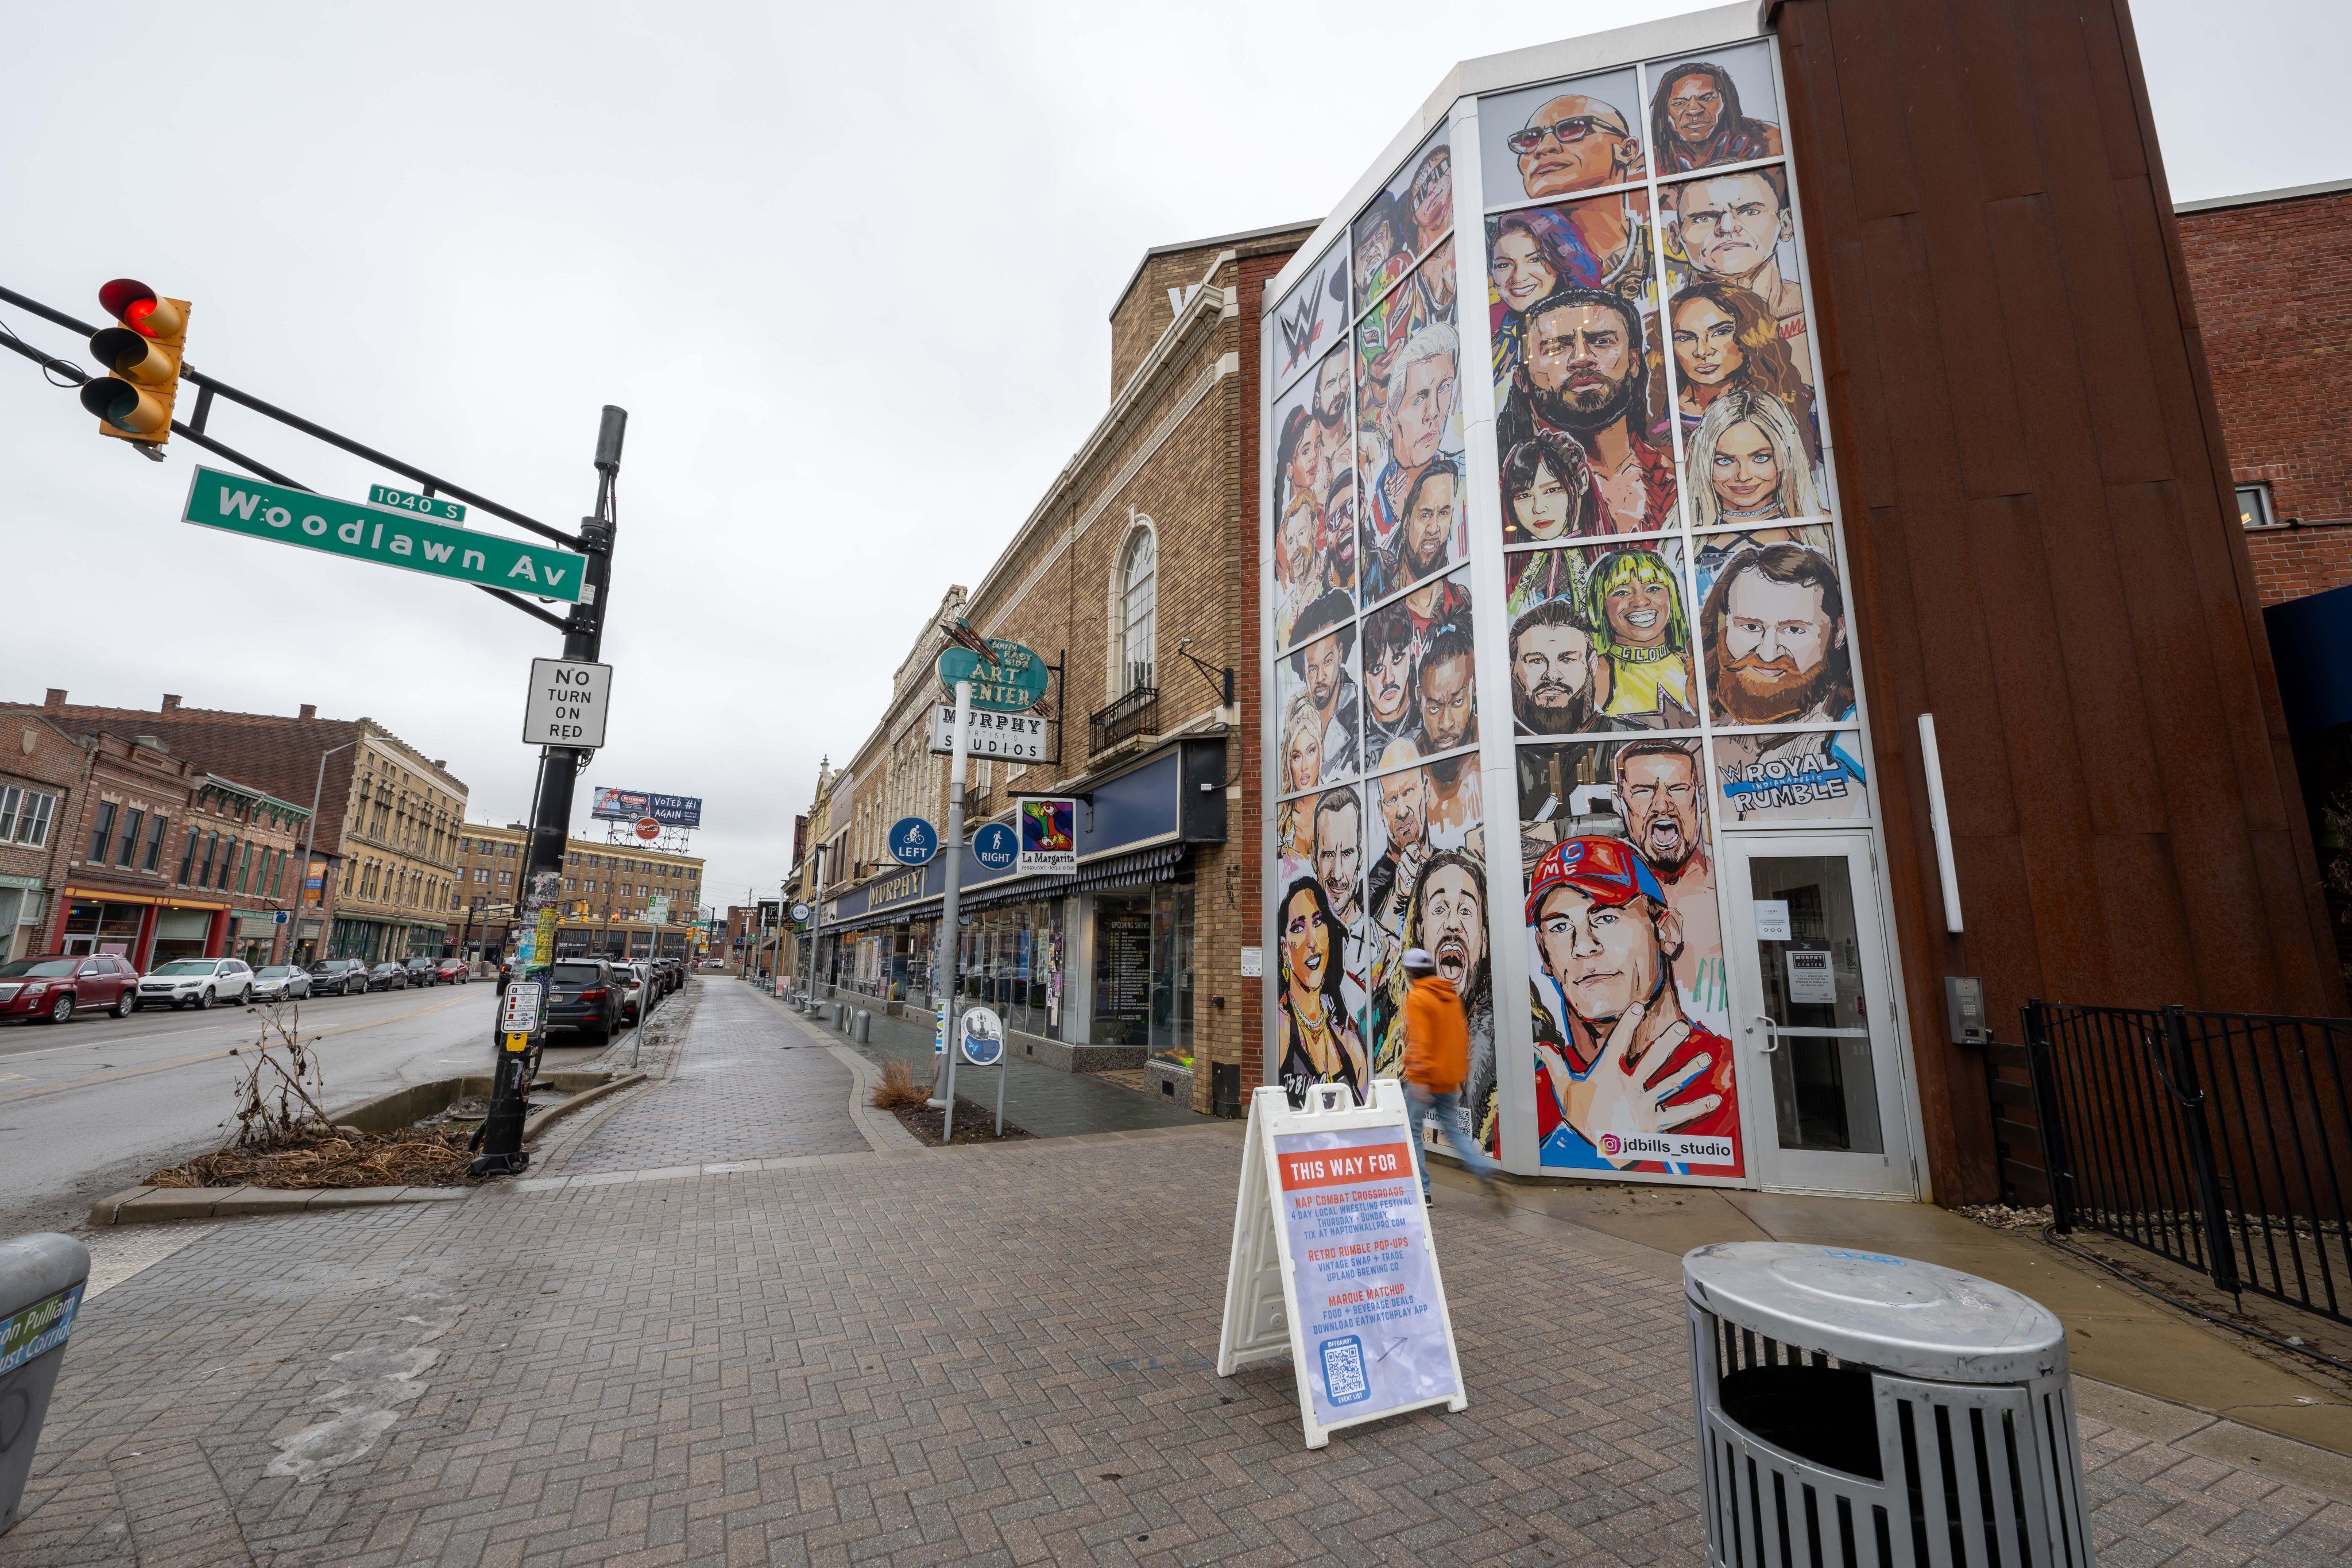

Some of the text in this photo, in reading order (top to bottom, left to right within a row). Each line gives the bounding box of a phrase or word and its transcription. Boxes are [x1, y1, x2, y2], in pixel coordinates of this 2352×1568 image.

[377, 489, 458, 520] 1040 S
[219, 486, 566, 586] Woodlawn Av
[992, 641, 1018, 652] SOUTH
[1004, 651, 1032, 661] EAST
[1005, 658, 1028, 668] SIDE
[555, 668, 590, 686] NO
[970, 663, 1022, 684] ART
[547, 688, 592, 704] TURN
[970, 682, 1030, 706] ENTER
[555, 706, 580, 720] ON
[942, 708, 1041, 735] MURPHY
[550, 723, 583, 738] RED
[967, 729, 1018, 741] ARTIST'S
[944, 735, 1036, 757] SUDIOS
[1745, 753, 1840, 783] ROYAL
[1752, 775, 1822, 790] INDIANAPOLIS
[655, 797, 681, 807] VOTED
[685, 800, 696, 809] #1
[1733, 777, 1848, 813] RUMBLE
[655, 810, 681, 819] AGAIN
[899, 847, 927, 858] LEFT
[981, 852, 1011, 862] RIGHT
[1022, 853, 1074, 866] La Margarita
[1542, 861, 1578, 880] ME
[870, 869, 923, 907] MURPHY
[650, 898, 655, 906] 2
[1623, 1138, 1731, 1156] jdbills_studio
[1290, 1153, 1397, 1180] THIS WAY FOR
[1295, 1186, 1405, 1209] NAP COMBAT CROSSROADS
[1291, 1197, 1413, 1221] 4 DAY LOCAL WRESTLING FESTIVAL
[1304, 1218, 1406, 1240] TIX AT NAPTOWNALLPRO.COM
[1317, 1215, 1353, 1228] THURSDAY
[1361, 1211, 1387, 1222] SUNDAY
[1308, 1237, 1409, 1262] RETRO RUMBLE POP-UPS
[1318, 1259, 1349, 1272] VINTAGE
[1351, 1255, 1371, 1267] SWAP
[1382, 1250, 1405, 1262] TRADE
[1327, 1262, 1399, 1282] UPLAND BREWING CO
[1328, 1283, 1405, 1307] MARQUE MATCHUP
[1323, 1295, 1414, 1321] FOOD + BEVERAGE DEALS
[0, 1296, 76, 1345] on Pulliam
[1313, 1304, 1428, 1335] DOWNLOAD EATWATCHPLAY APP
[1338, 1395, 1352, 1404] EVENT
